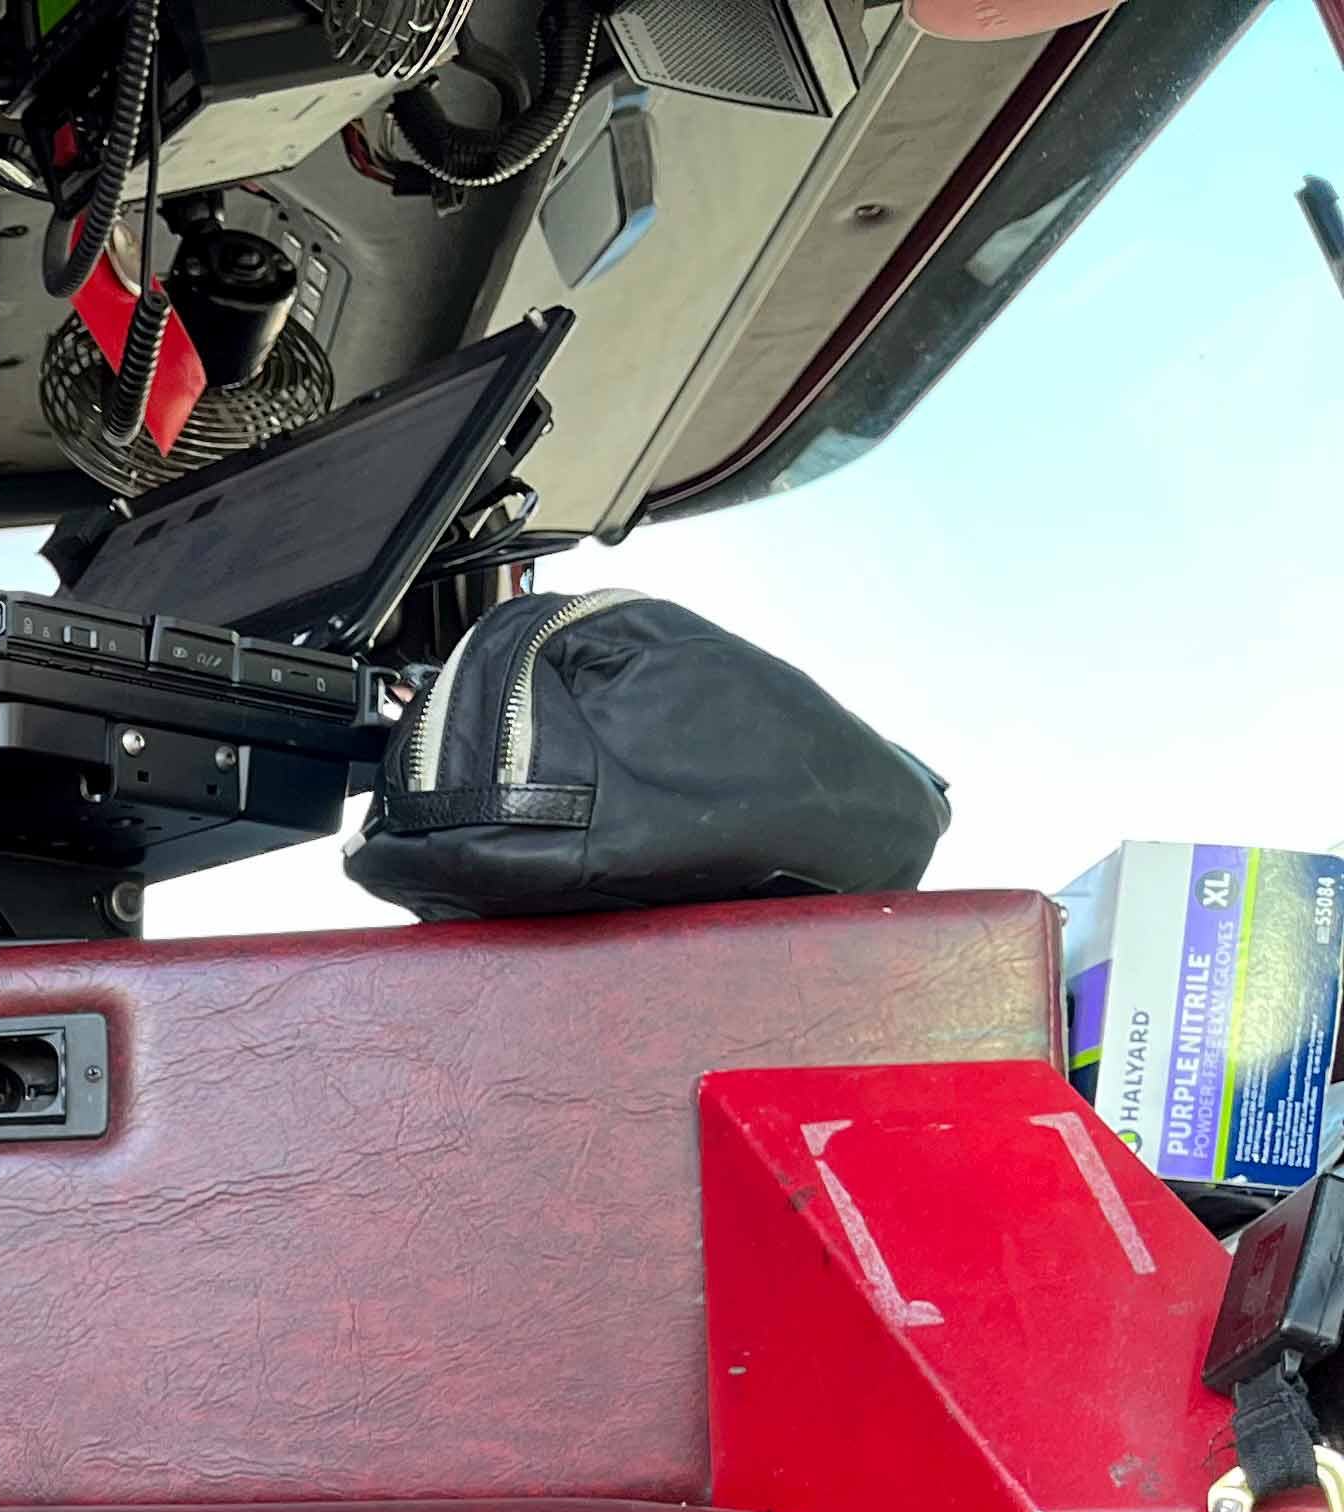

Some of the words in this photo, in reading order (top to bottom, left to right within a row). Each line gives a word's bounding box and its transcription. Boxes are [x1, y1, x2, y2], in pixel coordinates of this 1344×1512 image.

[1203, 872, 1230, 907] XL
[1315, 877, 1335, 926] 55084
[1212, 920, 1234, 987] GLOVES
[1179, 953, 1211, 1054] NITRILE
[1120, 1010, 1150, 1122] HALYARD
[1167, 1057, 1200, 1156] PURPLE
